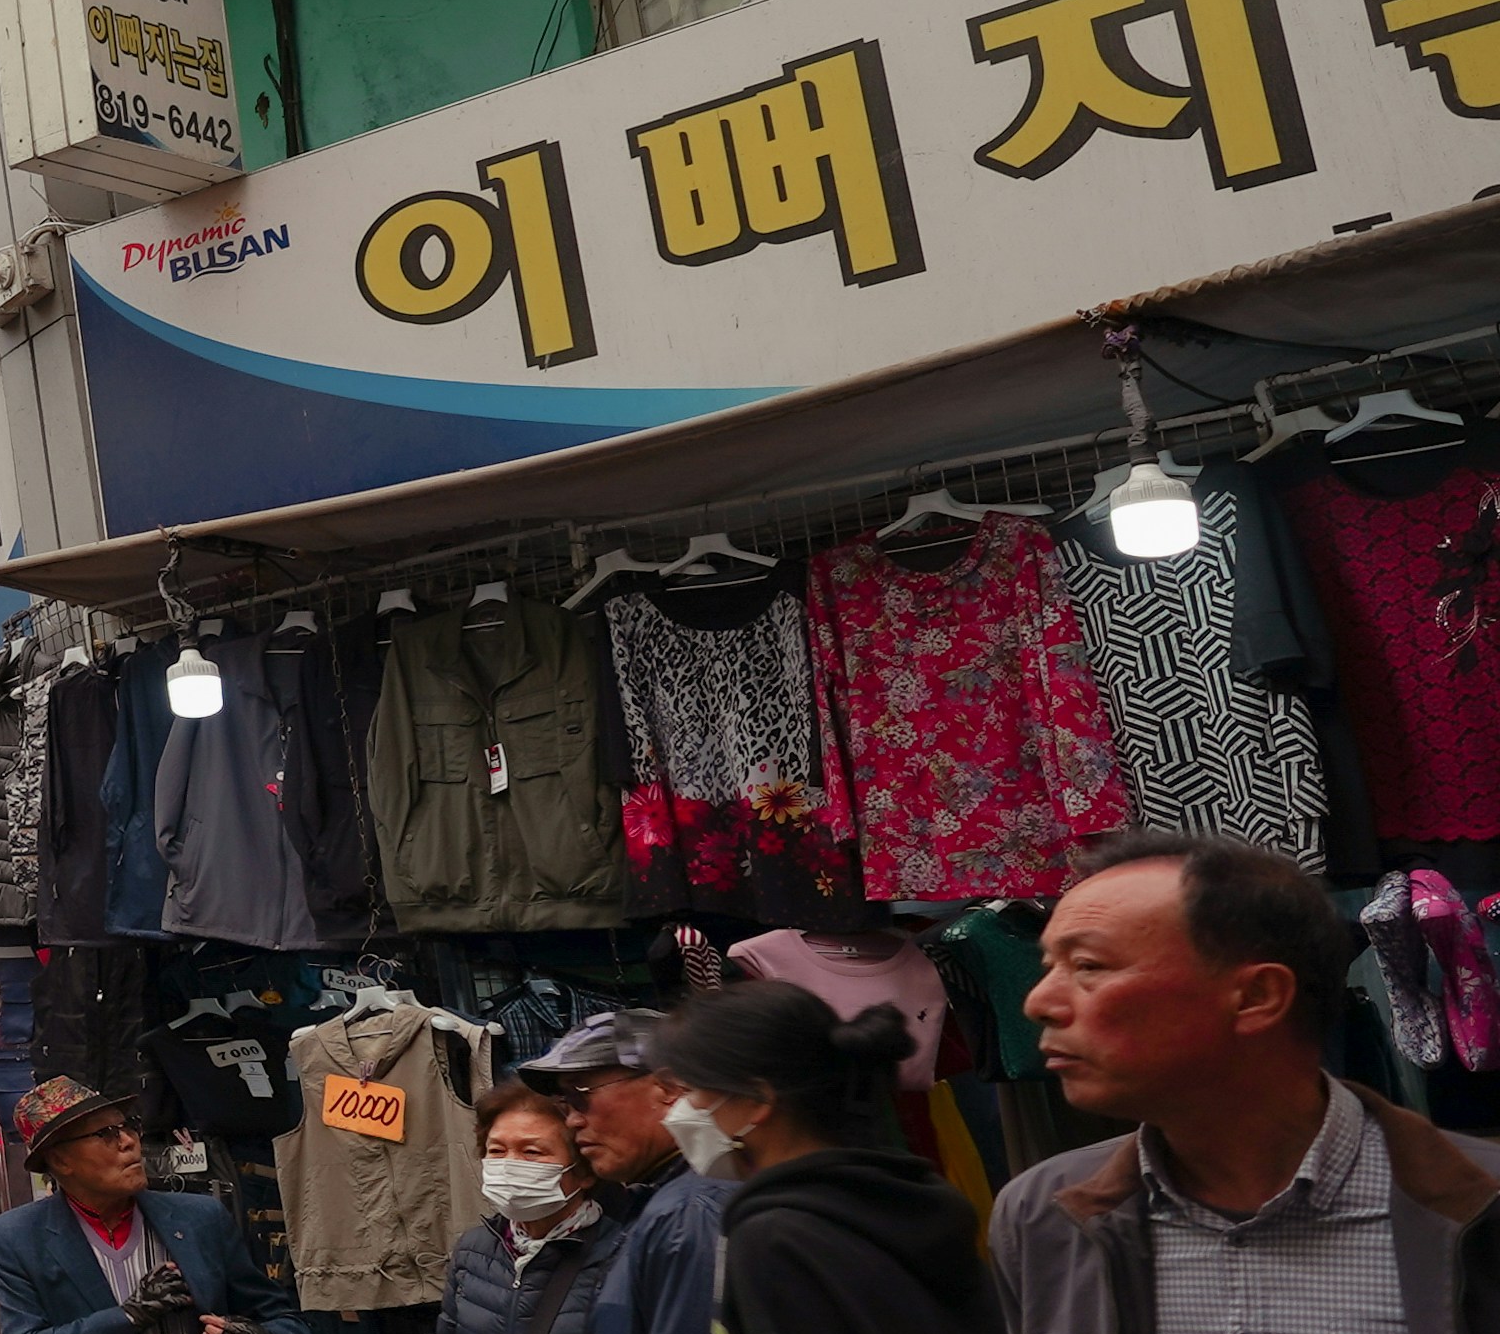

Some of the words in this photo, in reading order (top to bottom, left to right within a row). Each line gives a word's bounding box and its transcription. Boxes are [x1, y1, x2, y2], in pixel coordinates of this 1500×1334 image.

[96, 83, 235, 154] 819-6442
[121, 217, 246, 273] Dynamic
[169, 223, 291, 283] BUSAN
[329, 1089, 400, 1126] 10,000
